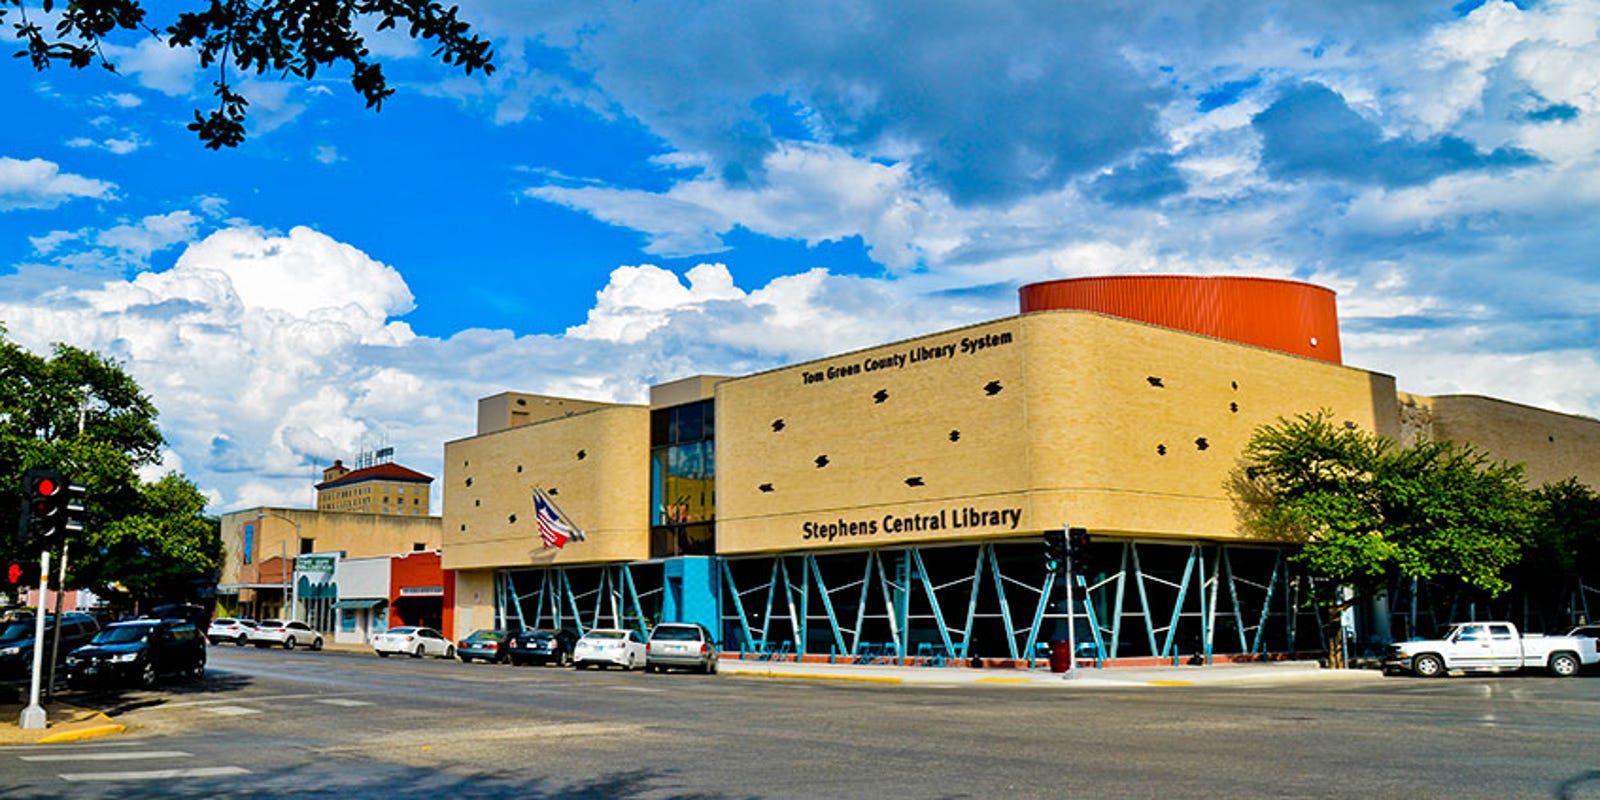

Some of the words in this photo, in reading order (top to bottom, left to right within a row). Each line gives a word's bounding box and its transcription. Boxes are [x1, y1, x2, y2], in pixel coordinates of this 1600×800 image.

[802, 372, 824, 384] Tom
[827, 364, 860, 380] Green
[863, 353, 906, 372] County
[909, 343, 956, 363] Library
[960, 331, 1013, 354] System
[803, 519, 877, 541] Stephens
[883, 510, 946, 533] Central
[953, 508, 1021, 529] Library
